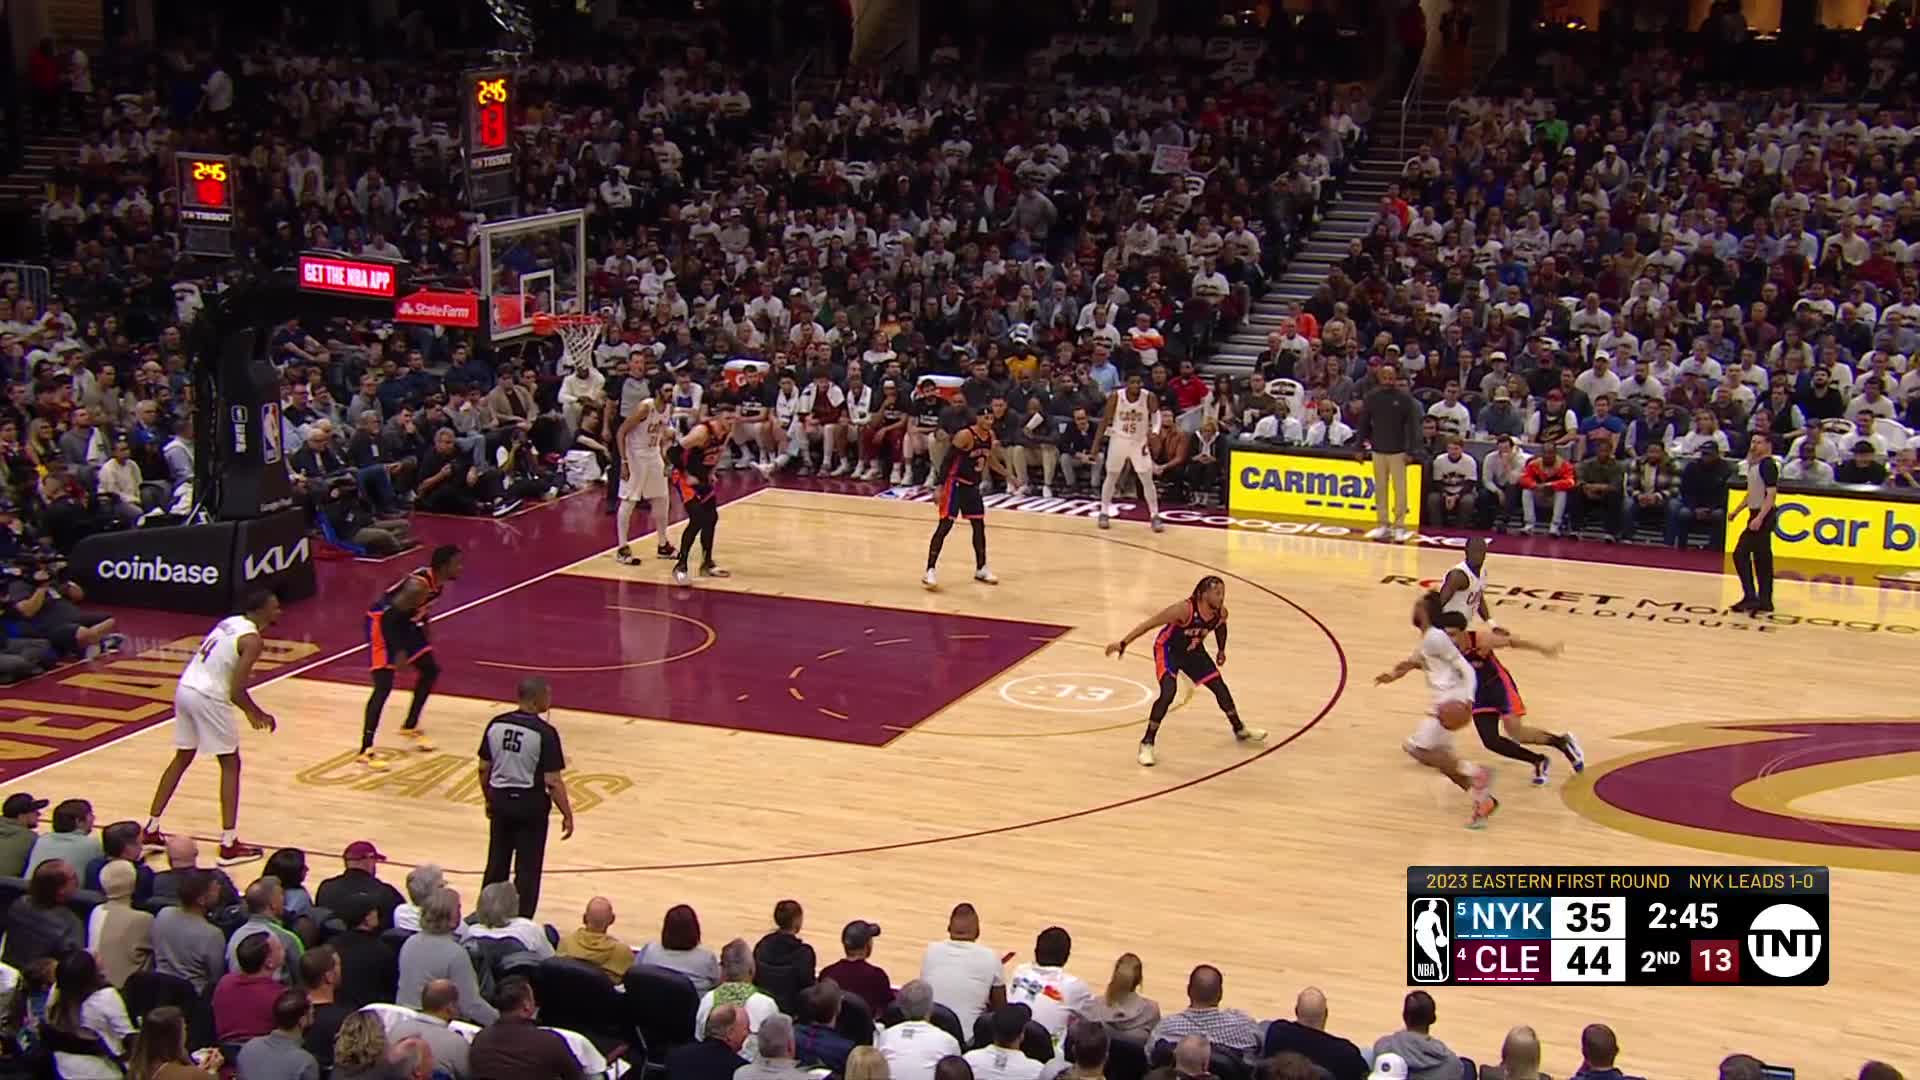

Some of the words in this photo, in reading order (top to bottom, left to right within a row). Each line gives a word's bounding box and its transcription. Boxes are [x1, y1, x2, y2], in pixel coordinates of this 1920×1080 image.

[304, 263, 324, 282] GET
[326, 265, 345, 285] THE
[347, 267, 368, 288] NBA
[370, 271, 390, 290] APP
[1157, 510, 1351, 537] Google
[1774, 503, 1869, 547] Car
[98, 556, 219, 584] coinbase
[502, 729, 524, 753] 25
